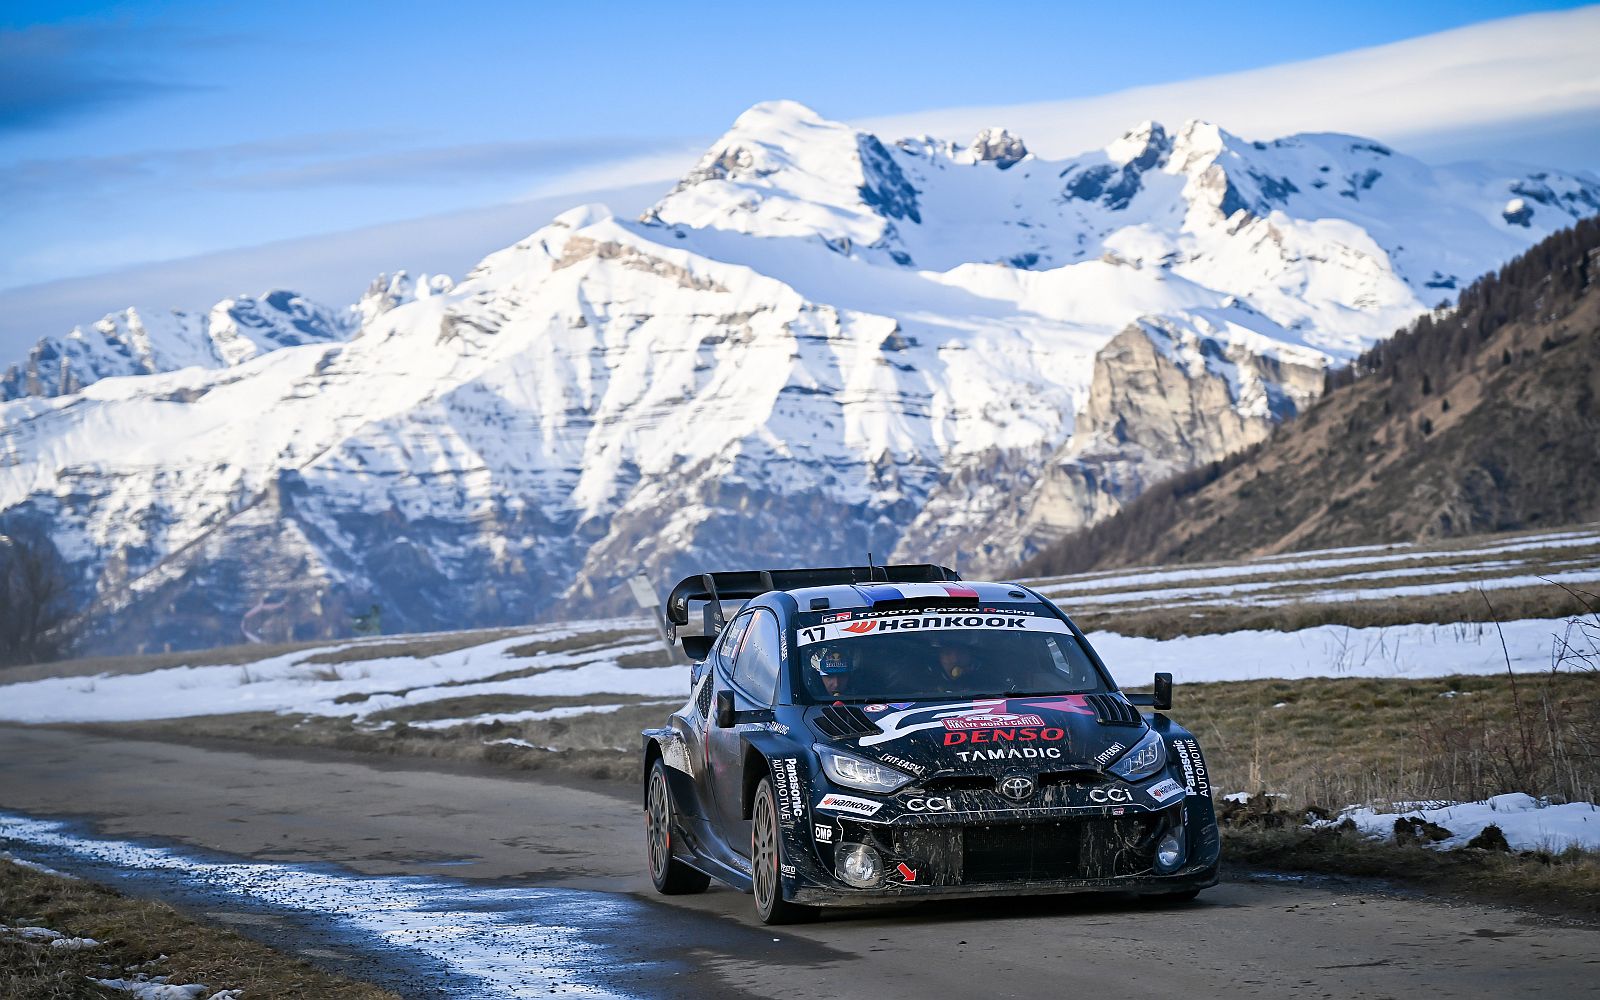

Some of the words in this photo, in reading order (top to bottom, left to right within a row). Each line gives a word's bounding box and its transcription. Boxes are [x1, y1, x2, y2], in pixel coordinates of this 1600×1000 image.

[855, 607, 920, 618] TOYOTA
[802, 627, 826, 642] 17
[946, 719, 978, 729] RALLYE
[943, 727, 1065, 746] DENSO
[956, 747, 1061, 763] TAMADIC
[1172, 739, 1198, 796] Panasonic
[1184, 738, 1209, 798] AUTOMOTIVE
[772, 759, 791, 823] AUTOMOTIVE
[784, 758, 803, 817] Panasonic
[815, 826, 833, 842] OMP
